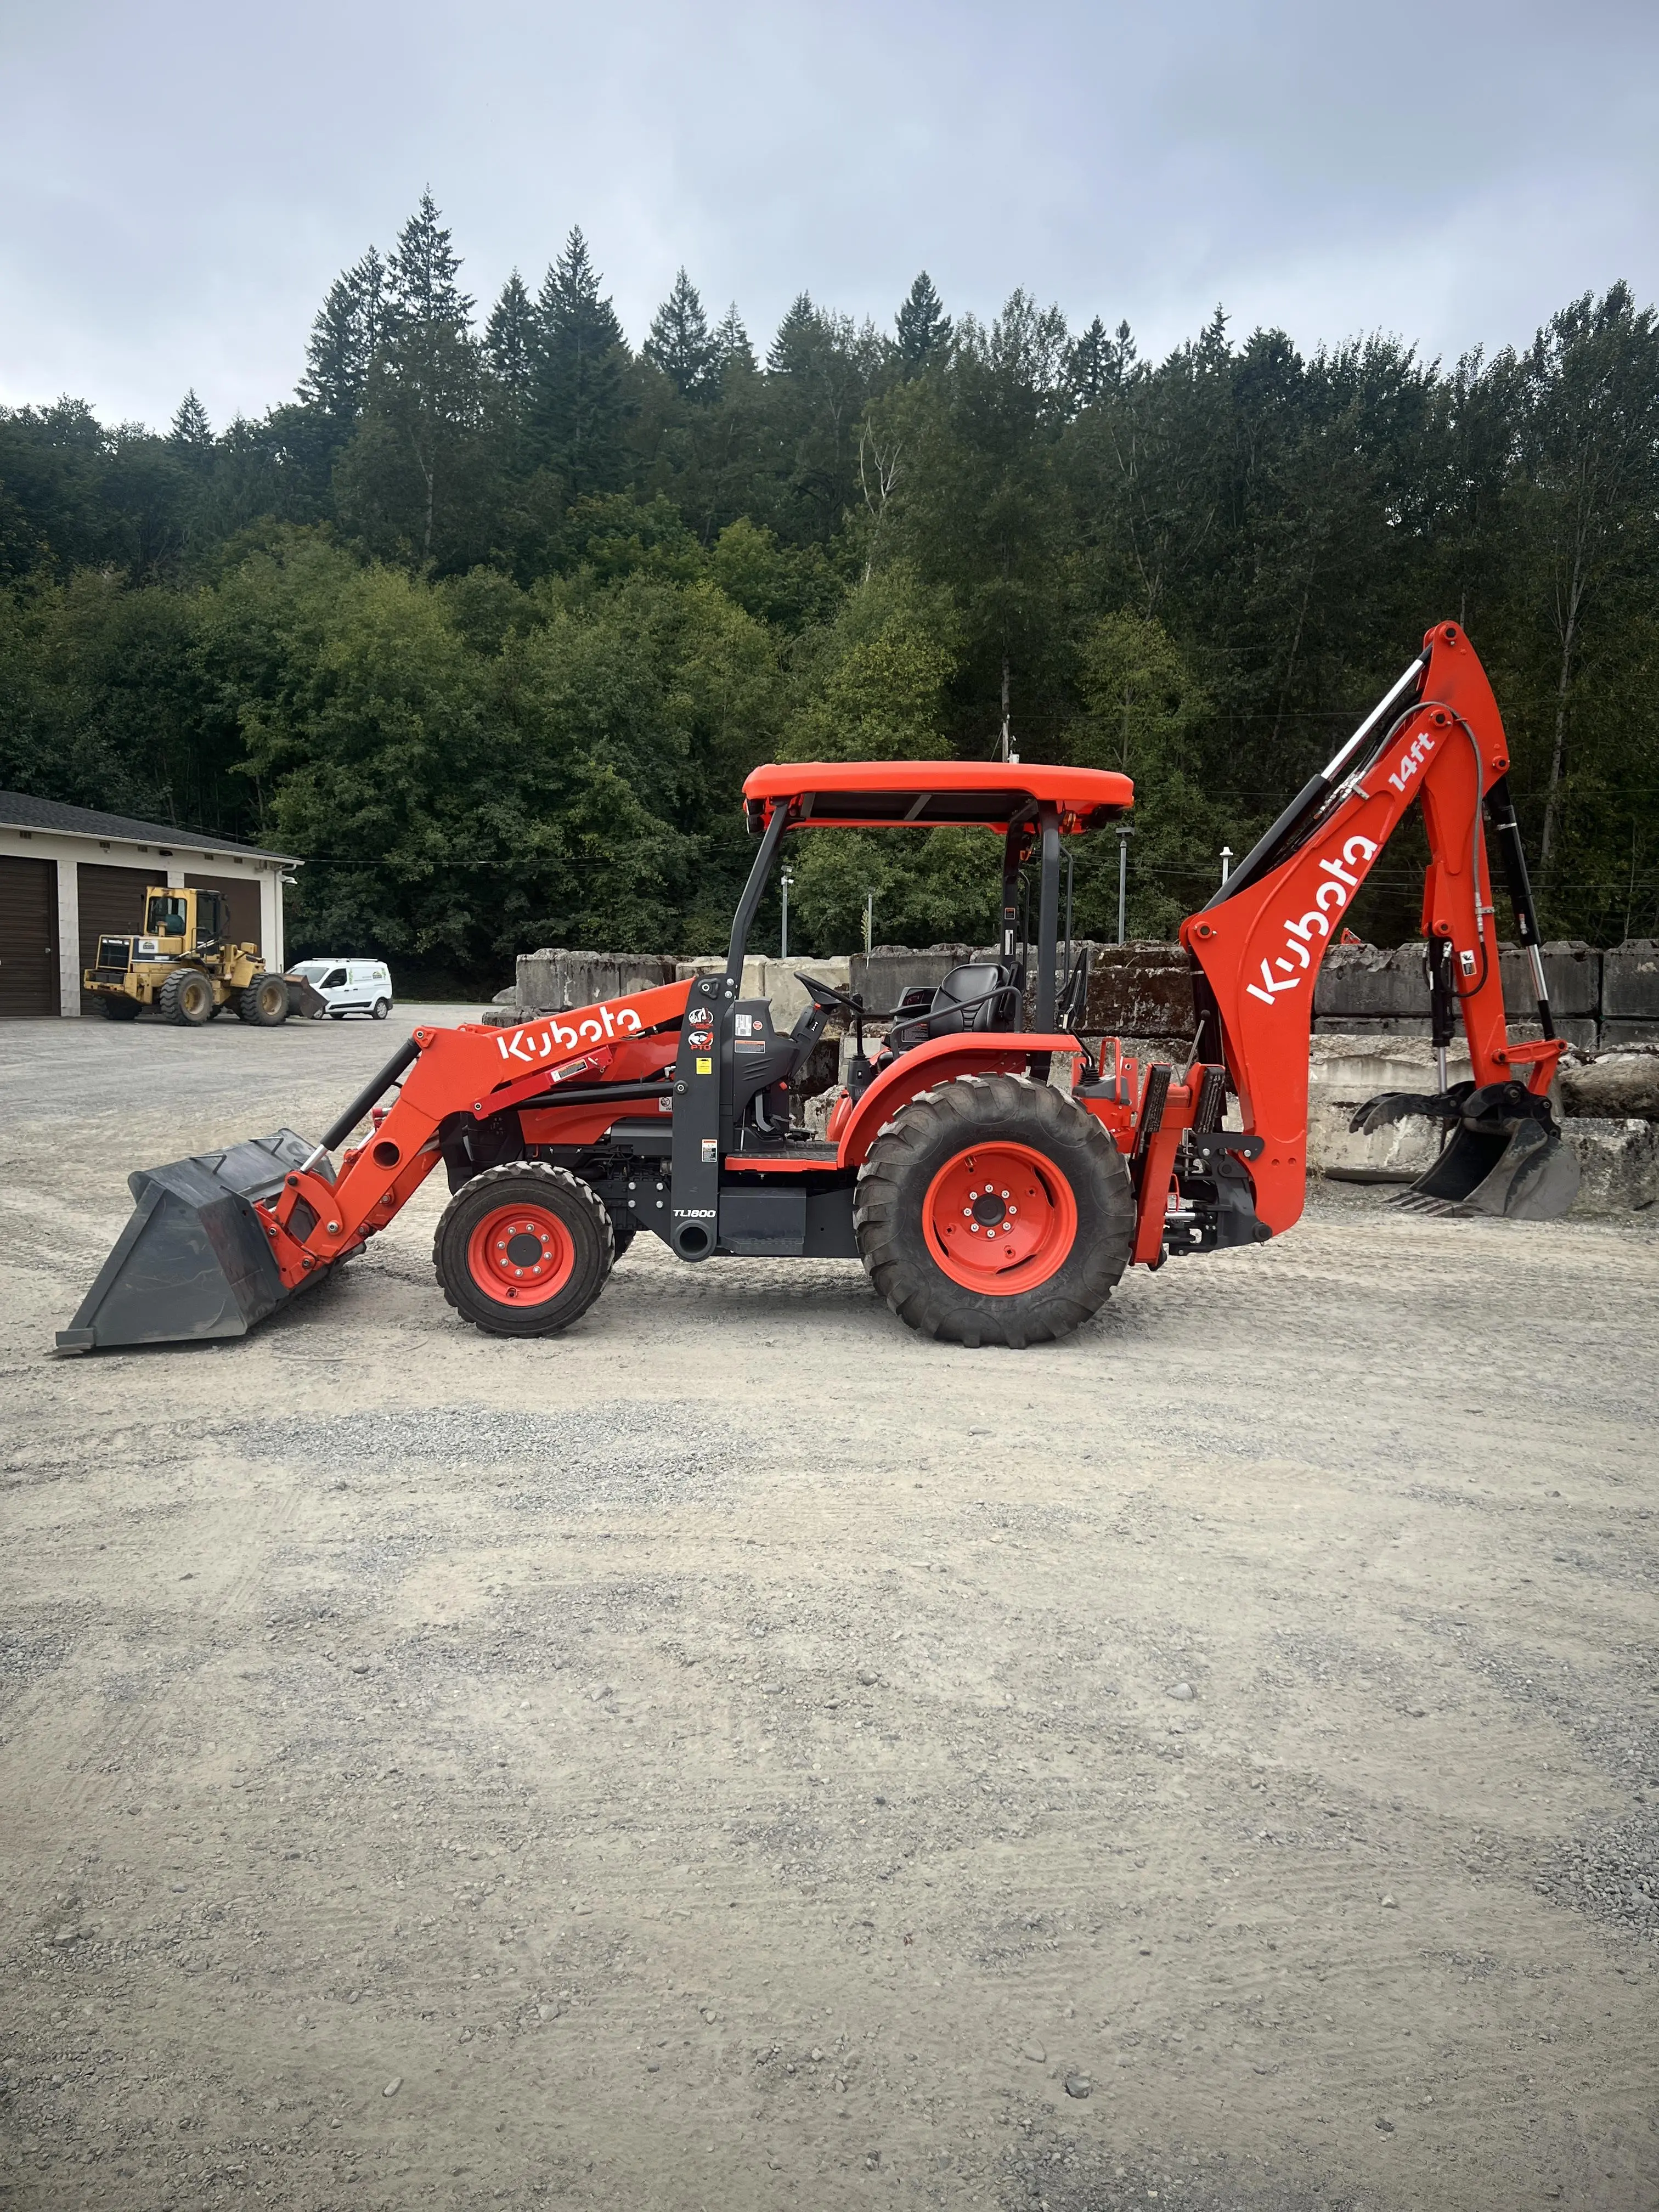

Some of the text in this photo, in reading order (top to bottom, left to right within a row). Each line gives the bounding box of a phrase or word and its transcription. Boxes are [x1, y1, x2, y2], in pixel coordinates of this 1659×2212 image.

[1388, 732, 1435, 792] 14ft
[1246, 836, 1379, 1006] Kubota
[496, 1006, 642, 1062] Kubota
[673, 1209, 716, 1218] TL1800
